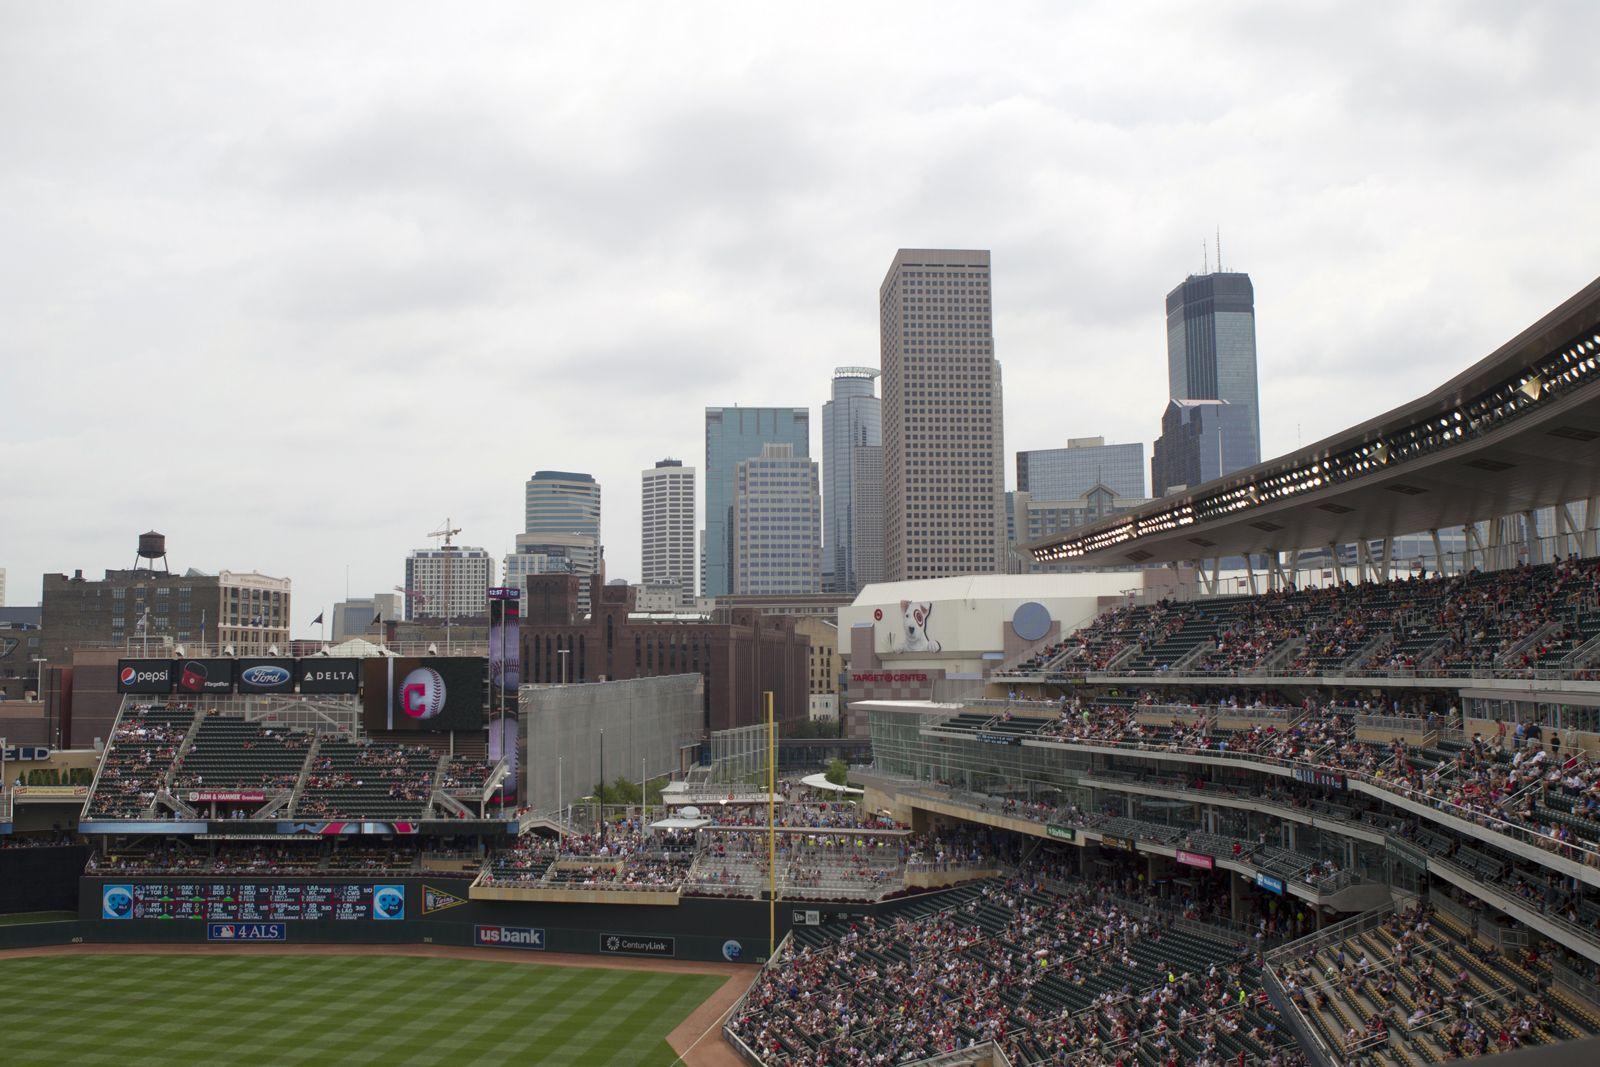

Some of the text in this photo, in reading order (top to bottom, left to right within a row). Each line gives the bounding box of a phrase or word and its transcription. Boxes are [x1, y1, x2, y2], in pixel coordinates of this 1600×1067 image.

[138, 670, 168, 682] pepsi
[252, 670, 280, 682] Ford
[316, 672, 354, 680] DELTA
[404, 684, 426, 718] C
[239, 925, 278, 938] 4 ALS
[622, 940, 666, 950] CenturyLink
